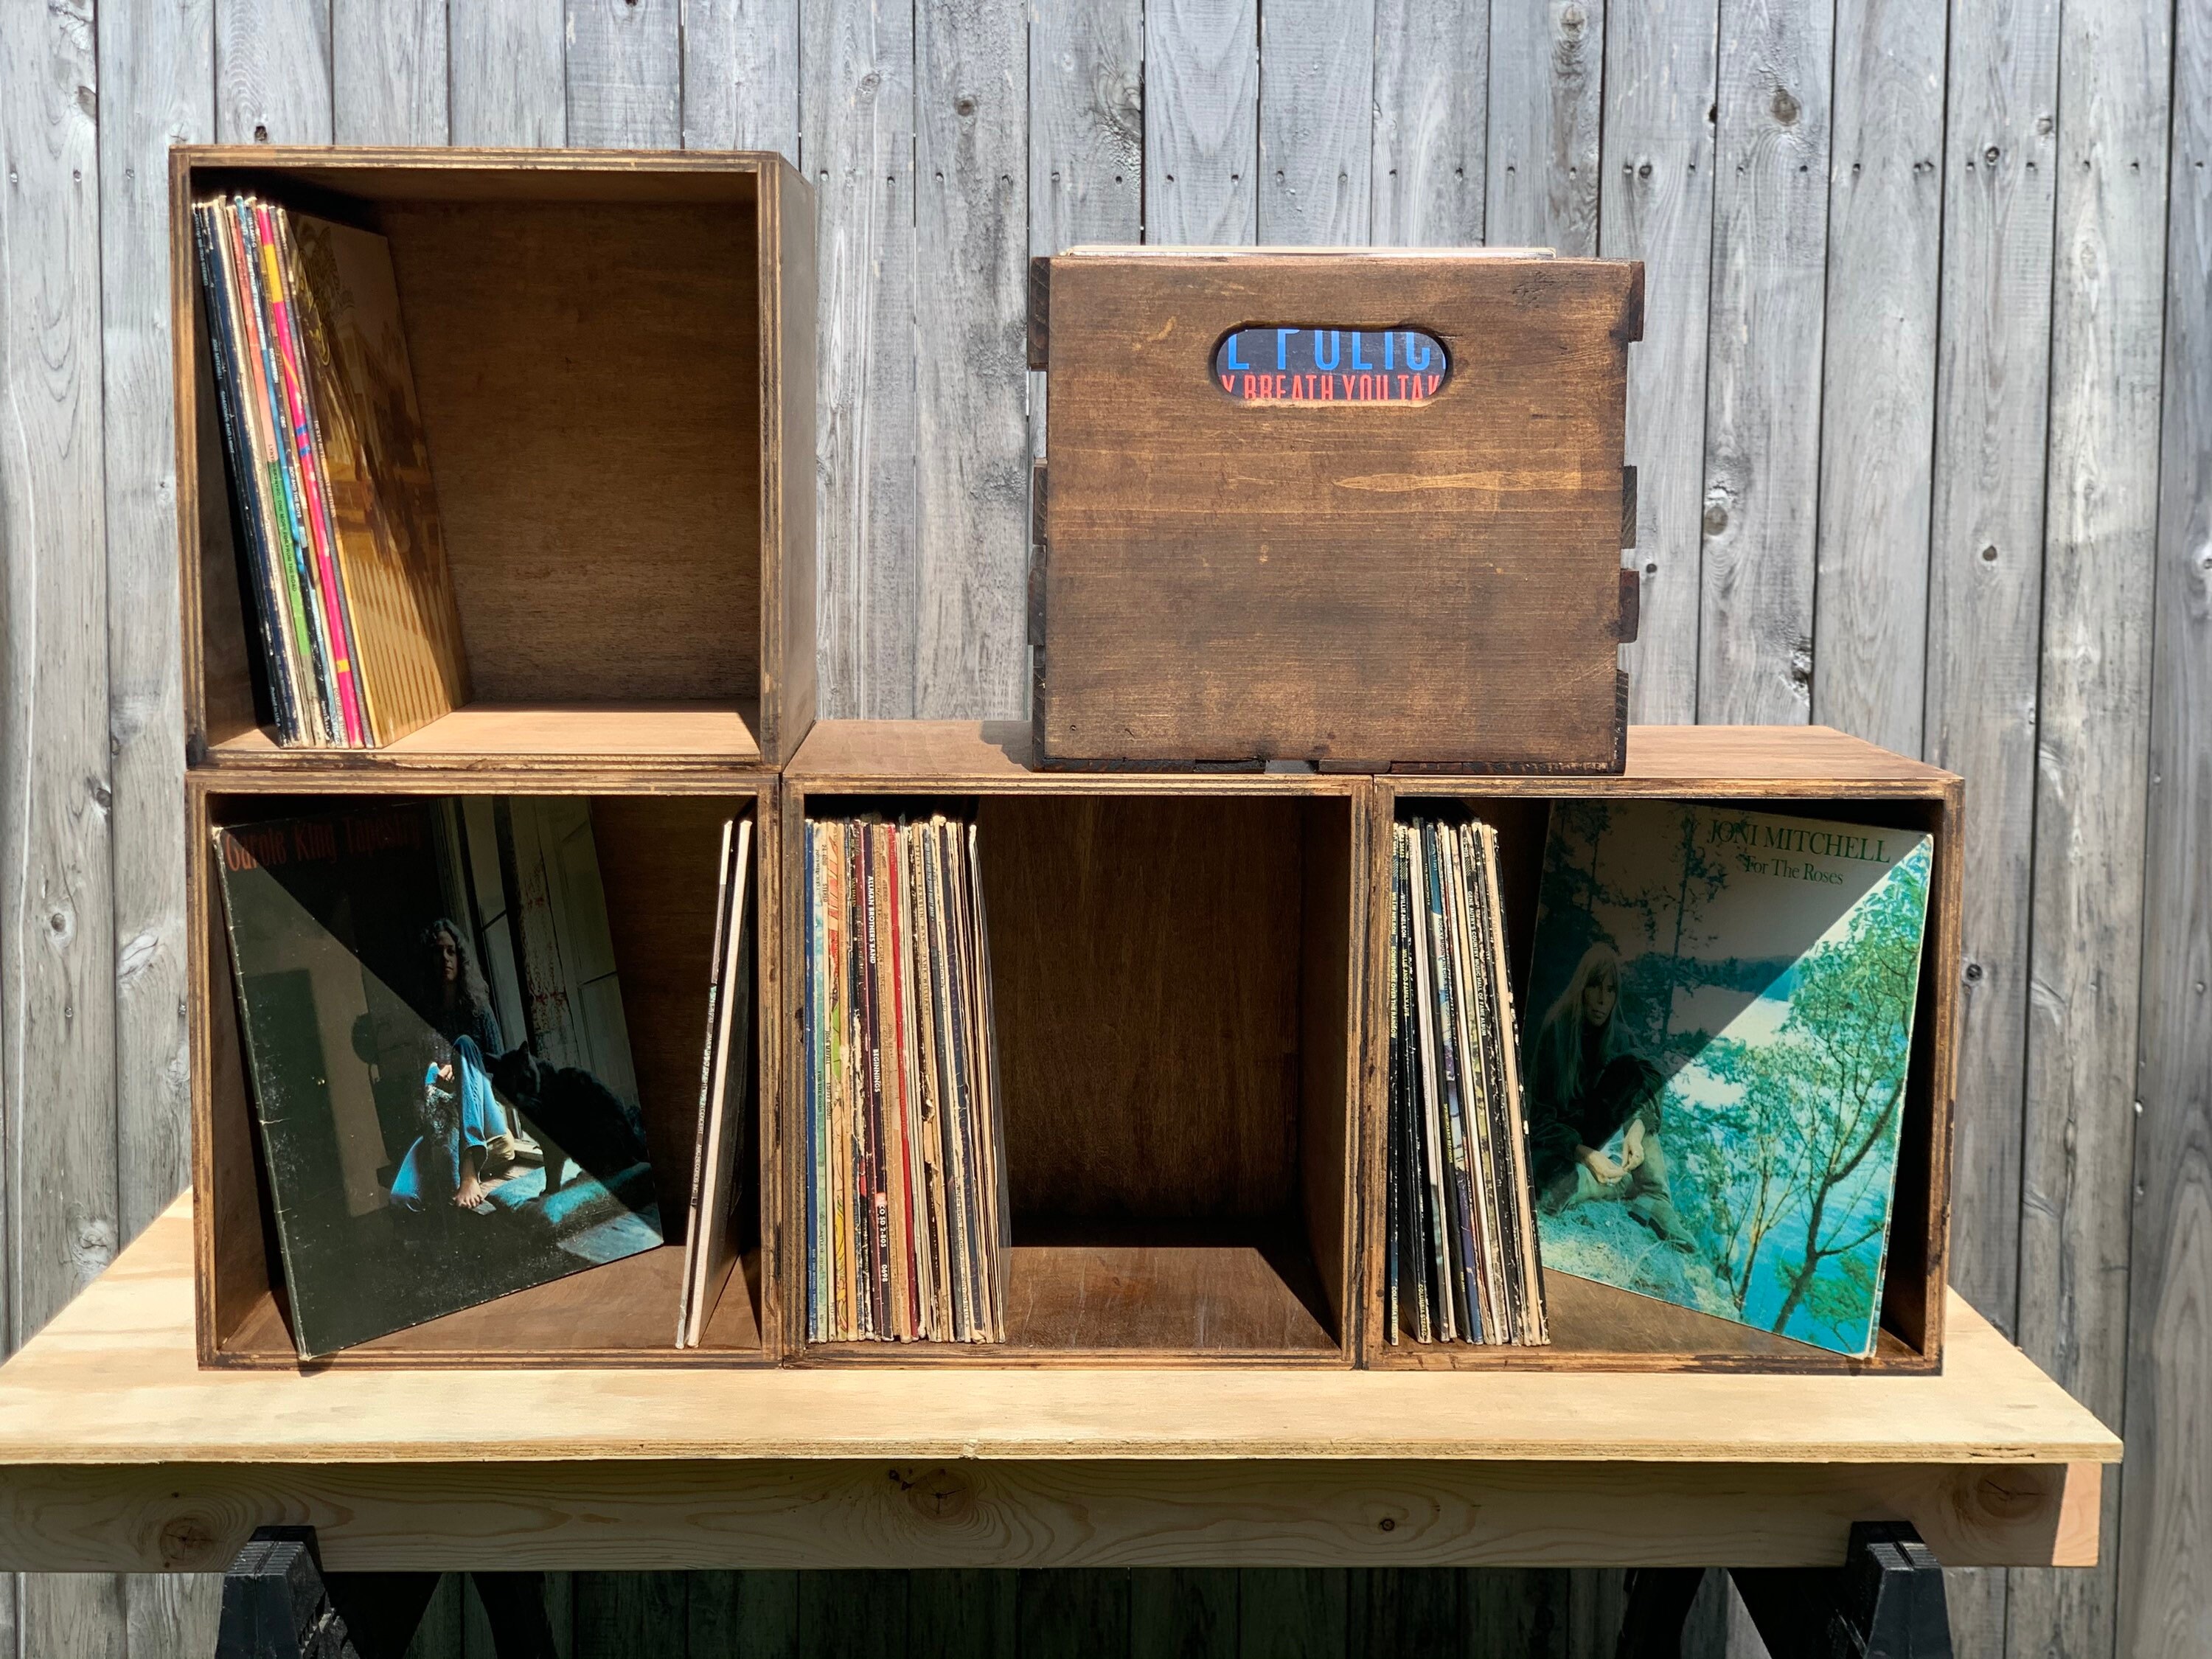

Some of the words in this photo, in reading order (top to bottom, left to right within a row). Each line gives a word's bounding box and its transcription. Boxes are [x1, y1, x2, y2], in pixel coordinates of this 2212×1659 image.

[1278, 329, 1446, 370] POLIC
[214, 352, 223, 380] MITCHELL
[1244, 375, 1333, 400] BREATH
[1342, 375, 1390, 400] YOU
[220, 390, 229, 422] SHADOWS
[313, 420, 322, 443] DICKEY
[294, 502, 302, 518] BOYS
[226, 827, 287, 872] Carole
[292, 824, 338, 866] King
[343, 813, 420, 858] Tapestry
[1707, 819, 1759, 846] JONI
[1763, 826, 1892, 863] MITCHELL
[1745, 855, 1769, 874] For
[1771, 858, 1800, 879] The
[1804, 863, 1844, 886] Roses
[948, 958, 957, 1012] SEPARATE
[1477, 992, 1483, 1001] OF
[872, 1048, 880, 1093] BEGINNINGS
[692, 1155, 700, 1183] RECORDS
[879, 1215, 886, 1225] SD
[1417, 1283, 1425, 1313] COLUMBIA
[1419, 1313, 1427, 1336] STEREO
